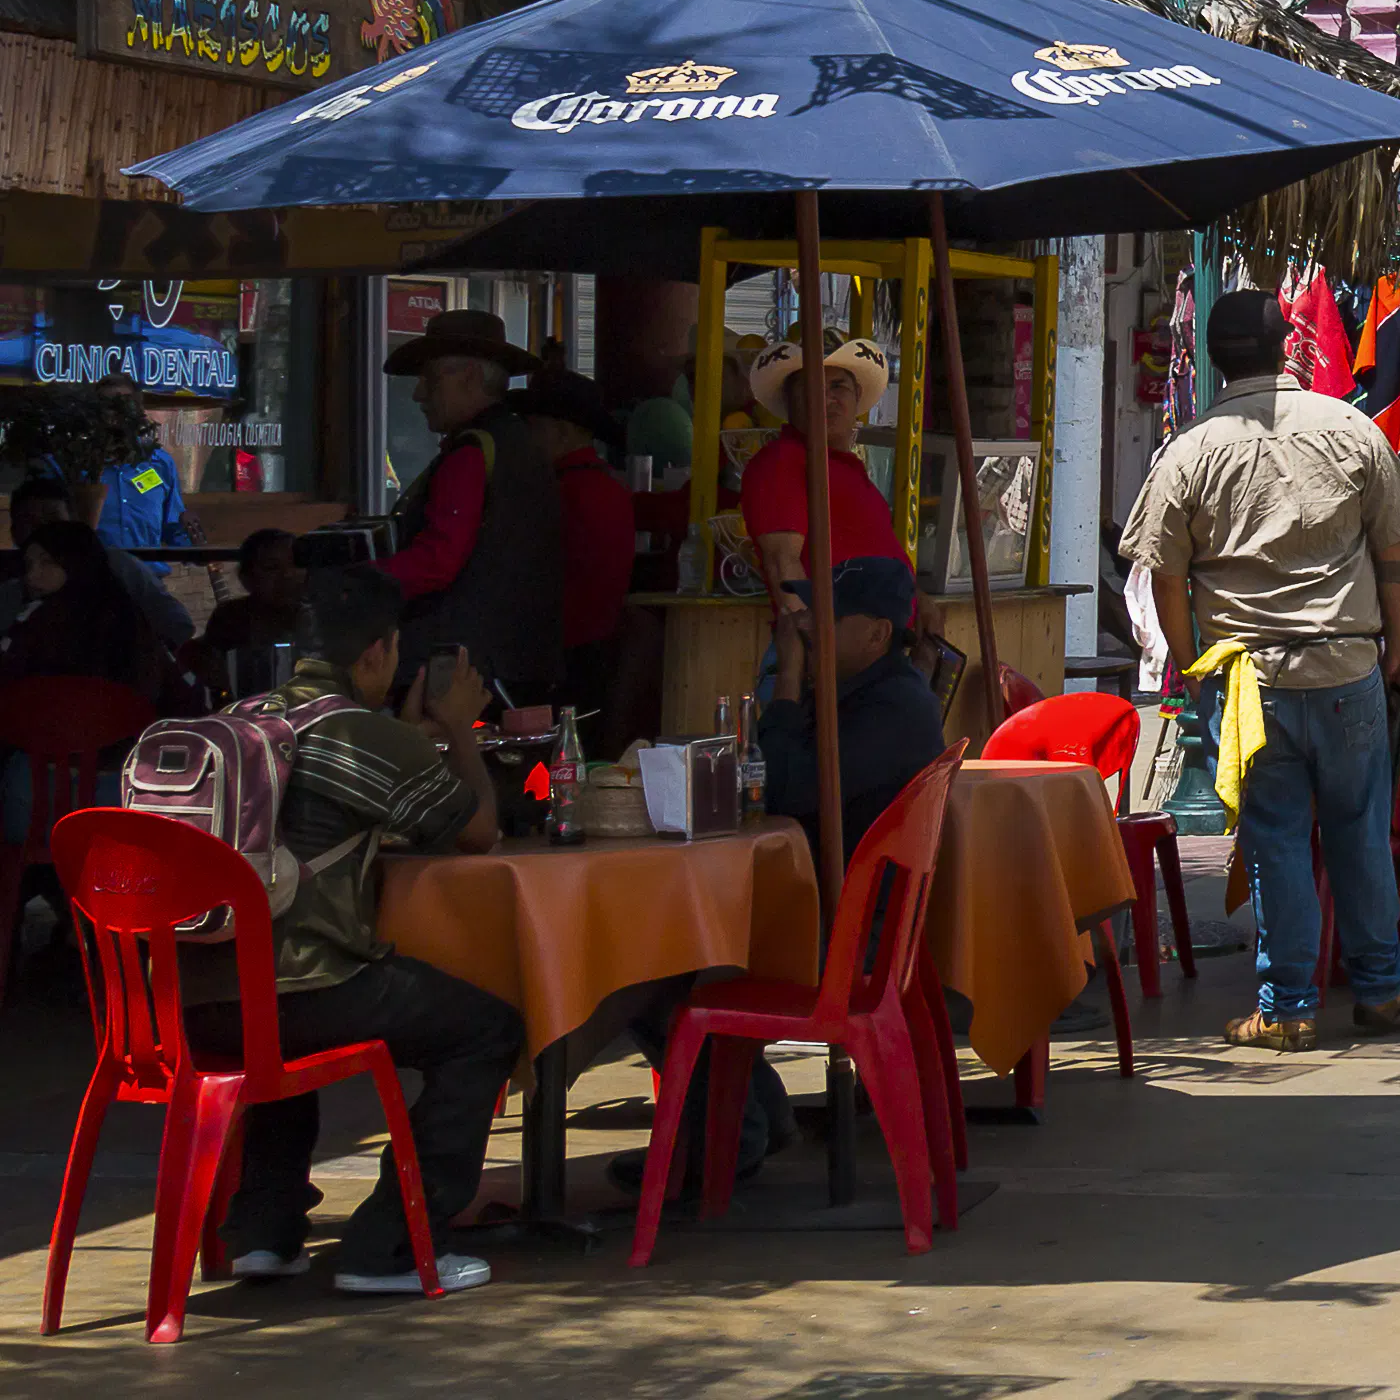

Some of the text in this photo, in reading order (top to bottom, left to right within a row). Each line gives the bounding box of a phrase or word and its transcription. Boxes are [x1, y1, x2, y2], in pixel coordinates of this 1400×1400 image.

[1011, 64, 1222, 106] Corona
[511, 90, 781, 134] Corona
[34, 343, 238, 388] CLINICA DENTAL
[906, 286, 927, 552] COCOS
[1041, 327, 1057, 554] COCOS
